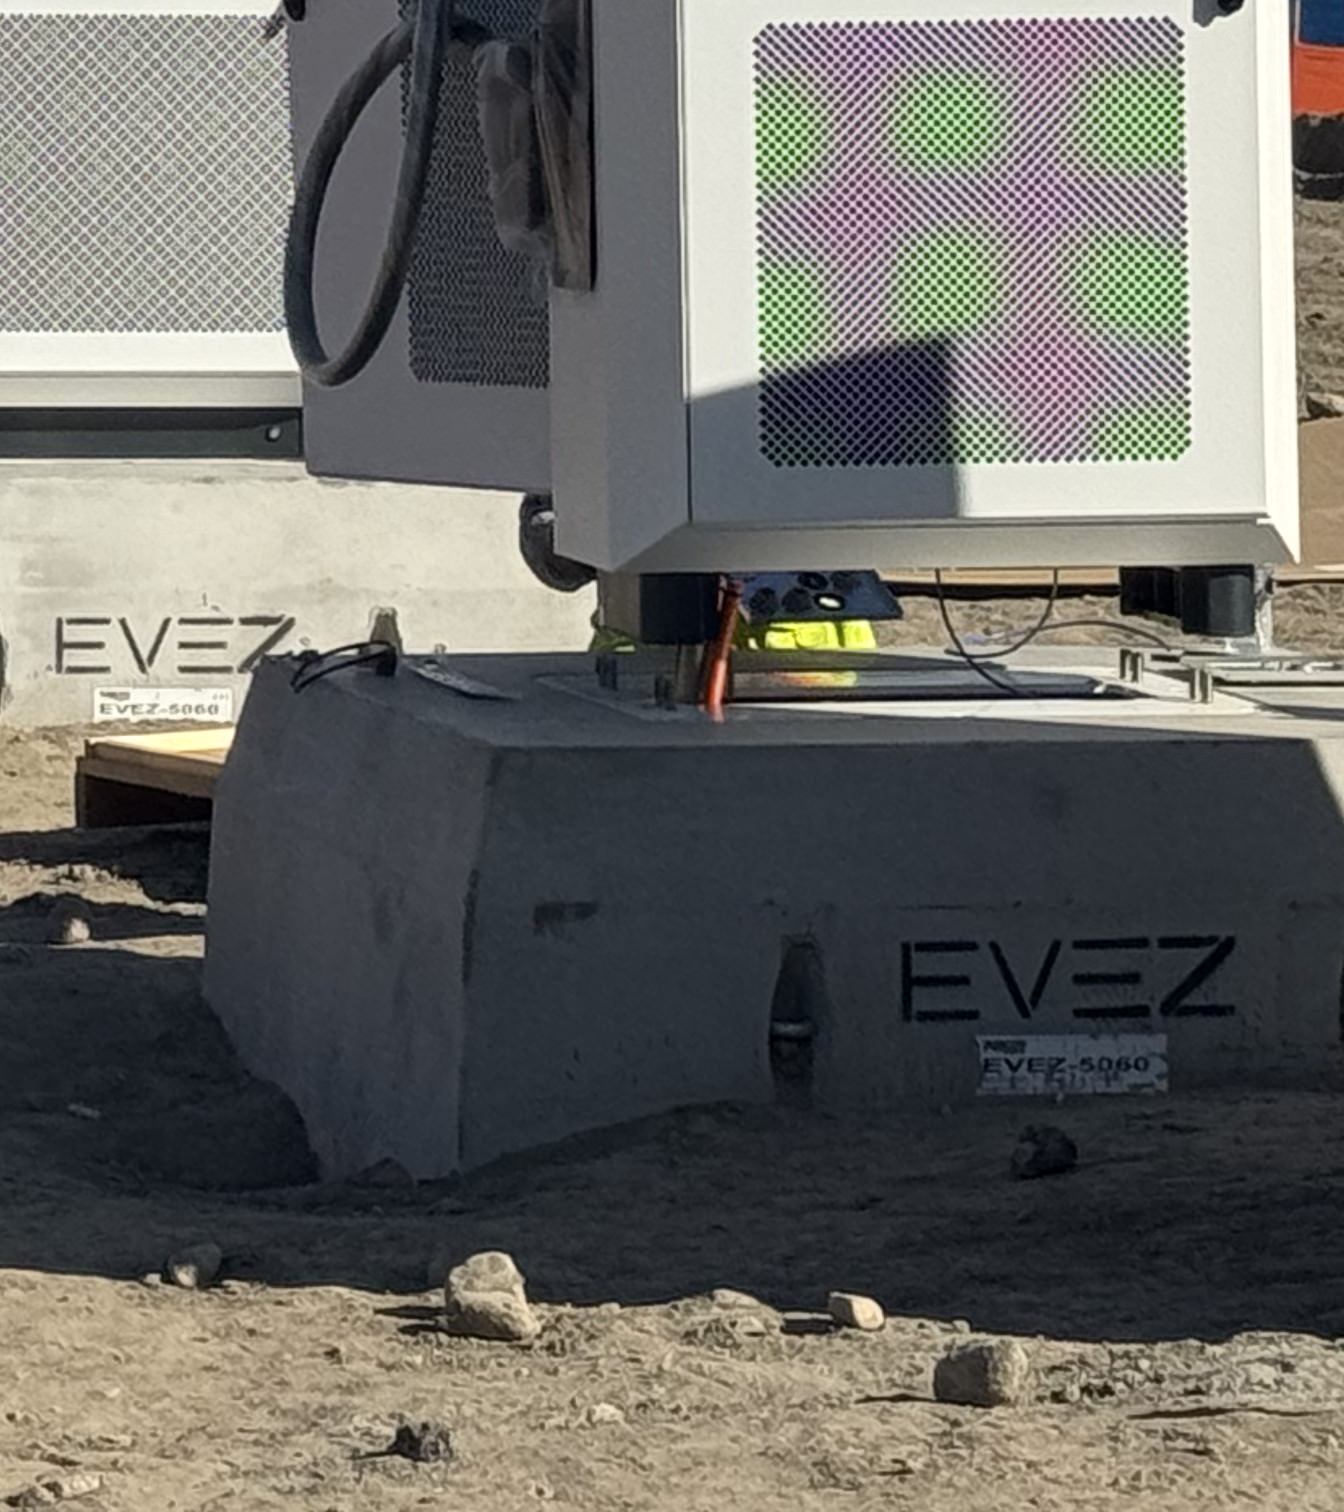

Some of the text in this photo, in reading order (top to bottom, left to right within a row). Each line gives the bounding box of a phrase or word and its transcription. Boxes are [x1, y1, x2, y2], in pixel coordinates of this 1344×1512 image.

[55, 614, 296, 675] EVEZ
[98, 702, 220, 716] EVEZ-5060
[901, 935, 1236, 1023] EVEZ
[982, 1056, 1151, 1074] EVEZ-5060
